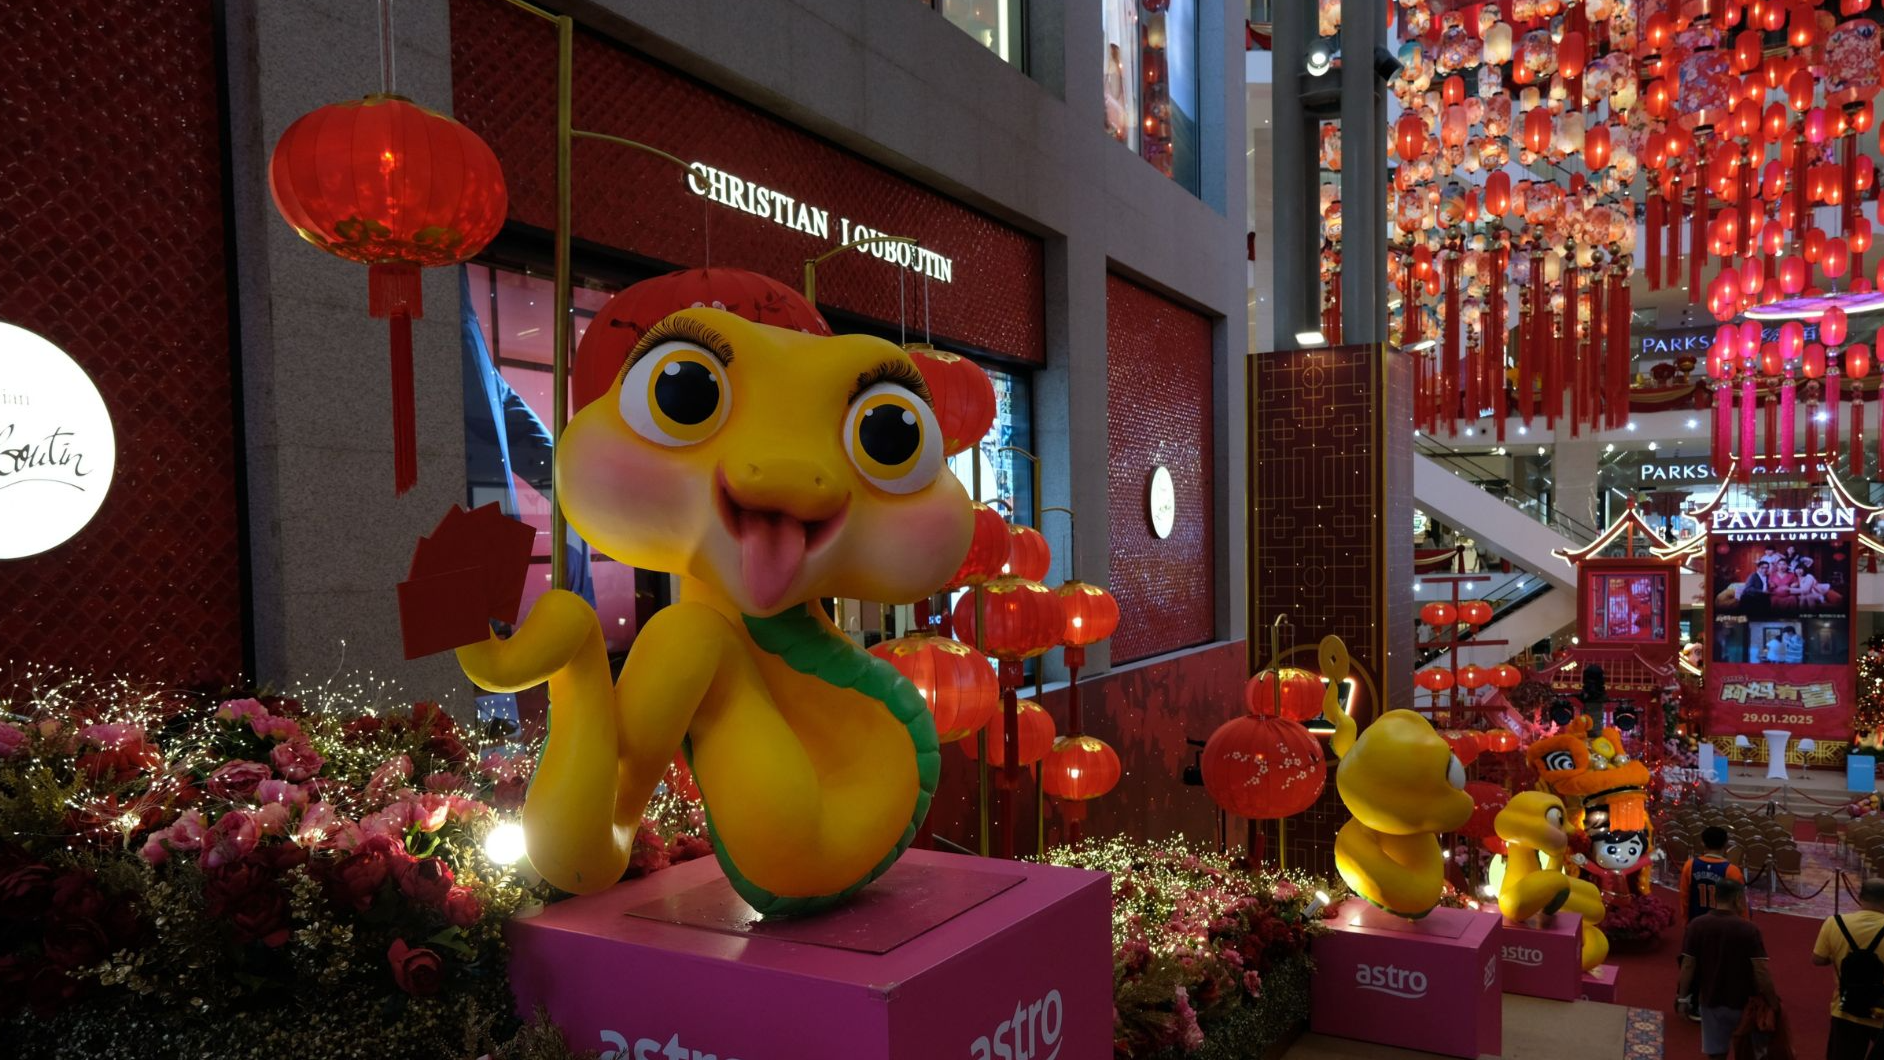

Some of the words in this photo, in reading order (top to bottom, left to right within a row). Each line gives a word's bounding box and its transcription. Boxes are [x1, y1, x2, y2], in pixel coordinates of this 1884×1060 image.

[687, 161, 829, 240] CHRISTIAN
[1642, 334, 1717, 353] PARKS
[1641, 463, 1717, 481] PARKS
[1711, 507, 1856, 529] PAVILION
[1727, 533, 1770, 541] KUALA
[1781, 533, 1838, 541] LUMPUR
[1742, 713, 1814, 725] 29.01.2025
[1697, 883, 1716, 909] 11
[1502, 945, 1543, 963] astro
[1355, 962, 1428, 993] astro
[970, 988, 1063, 1060] astro
[600, 1029, 741, 1060] ast
